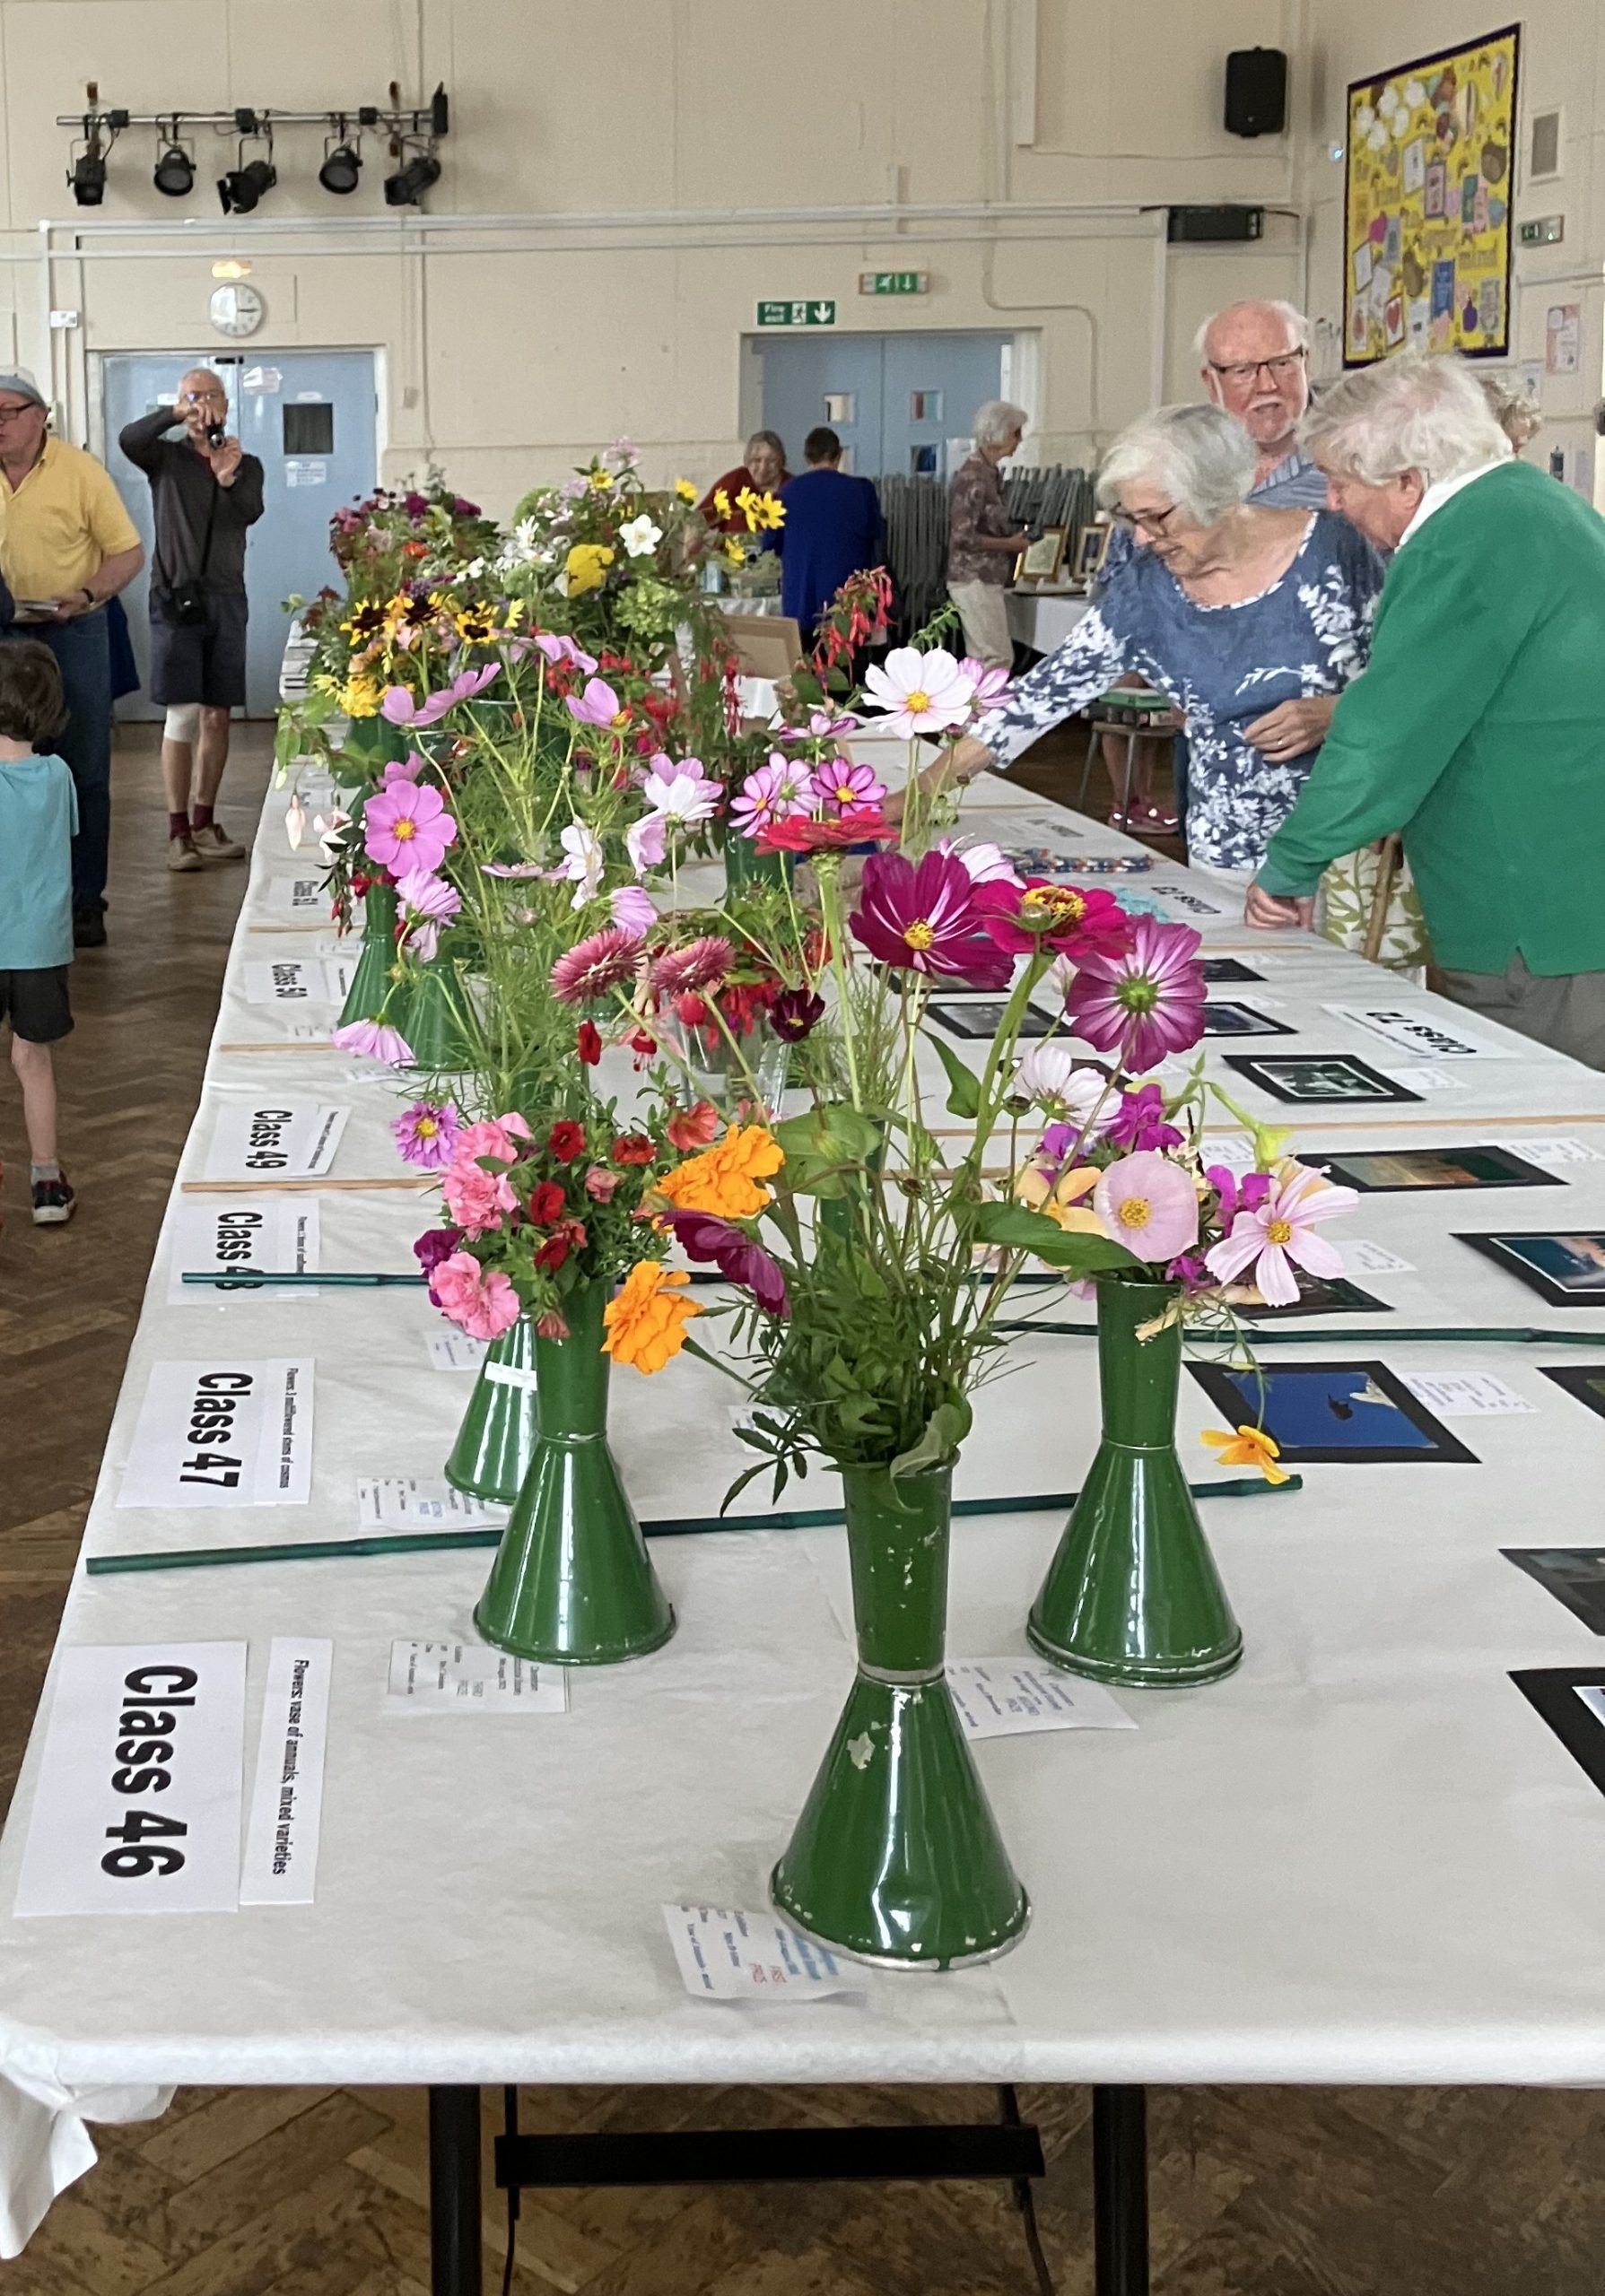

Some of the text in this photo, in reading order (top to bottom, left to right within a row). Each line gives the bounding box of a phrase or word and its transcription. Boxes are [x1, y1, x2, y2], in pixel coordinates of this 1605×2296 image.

[764, 304, 786, 314] Fire
[271, 963, 309, 999] Class 50
[1402, 1025, 1478, 1054] Class
[245, 1109, 293, 1170] Class 49
[215, 1212, 264, 1261] Class
[179, 1372, 254, 1488] Class 47
[100, 1665, 198, 1878] Class 46
[272, 1659, 310, 1875] Flowers: vase of annuals, mixed varieties
